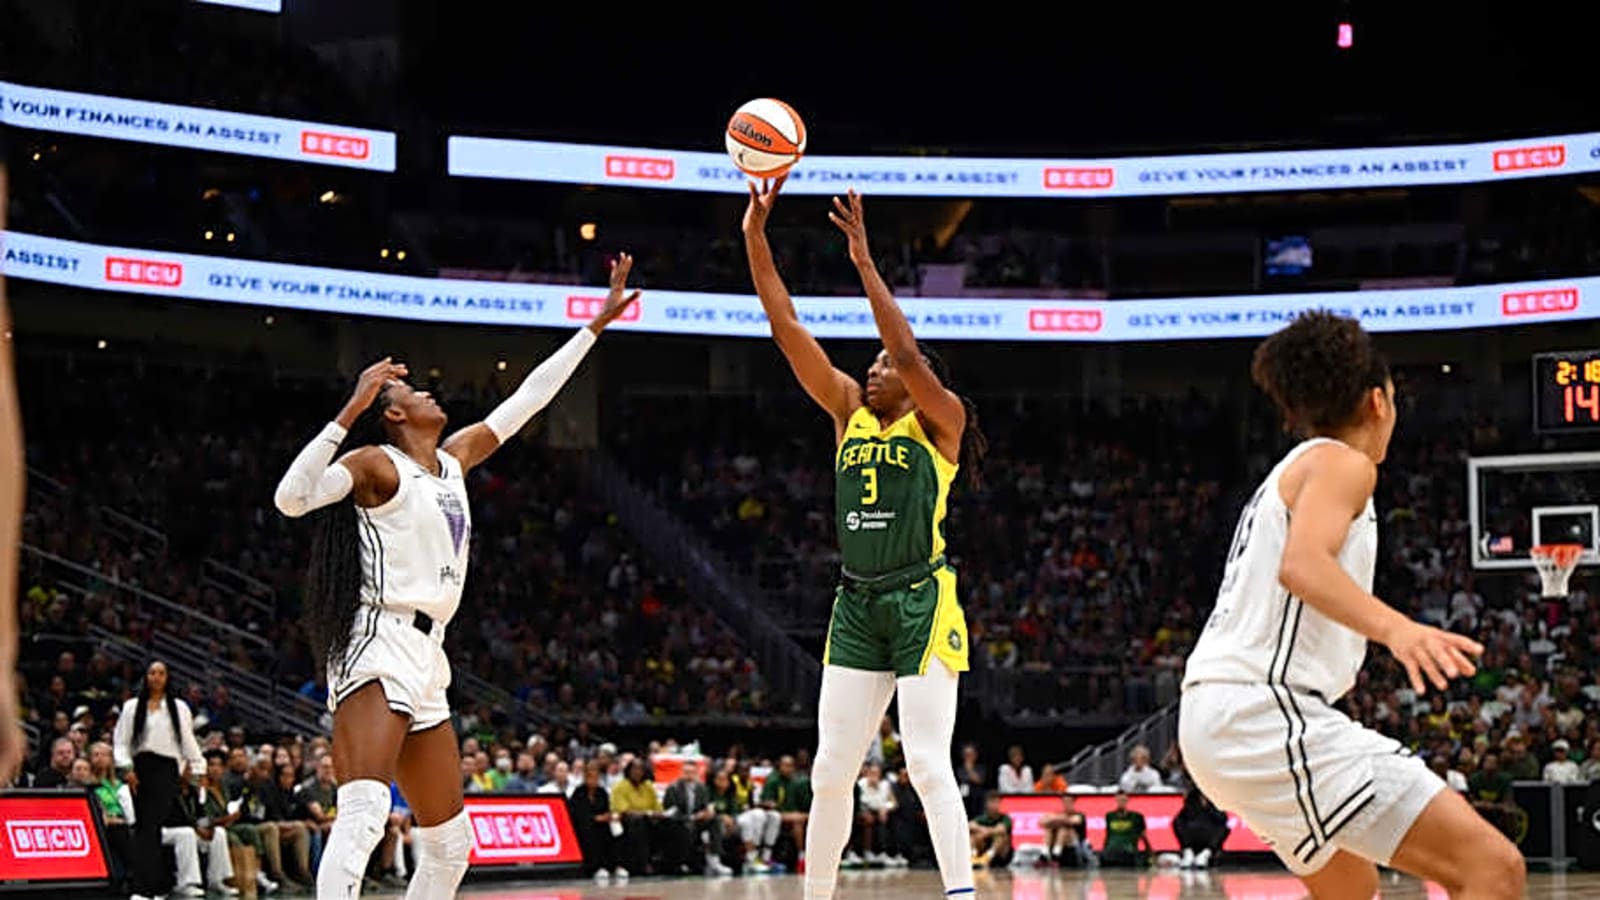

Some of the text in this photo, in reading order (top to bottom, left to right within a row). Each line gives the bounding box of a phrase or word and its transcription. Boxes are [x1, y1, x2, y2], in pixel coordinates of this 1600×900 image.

[10, 99, 60, 117] YOUR
[65, 107, 169, 131] FINANCES
[175, 122, 200, 134] AN
[207, 125, 281, 144] ASSIST
[305, 135, 366, 157] BECU
[609, 159, 670, 177] BECU
[1498, 149, 1561, 168] BECU
[807, 170, 907, 184] FINANCES
[914, 171, 937, 183] AN
[945, 170, 1019, 184] ASSIST
[1049, 170, 1110, 186] BECU
[1138, 159, 1467, 183] GIVE YOUR FINANCES AN ASSIST
[5, 248, 80, 271] ASSIST
[110, 261, 179, 284] BECU
[208, 273, 546, 312] GIVE YOUR FINANCES AN ASSIST
[1506, 293, 1575, 313] BECU
[665, 307, 716, 321] GIVE
[924, 314, 1003, 326] ASSIST
[1033, 312, 1098, 328] BECU
[1128, 314, 1180, 327] GIVE
[1189, 312, 1241, 324] YOUR
[1362, 305, 1387, 317] AN
[1394, 302, 1474, 317] ASSIST
[1556, 360, 1600, 385] 2:18
[1564, 385, 1599, 422] 14
[842, 441, 910, 472] SEATTLE
[861, 468, 878, 505] 3
[15, 828, 83, 849] BECU
[473, 815, 551, 846] BECU
